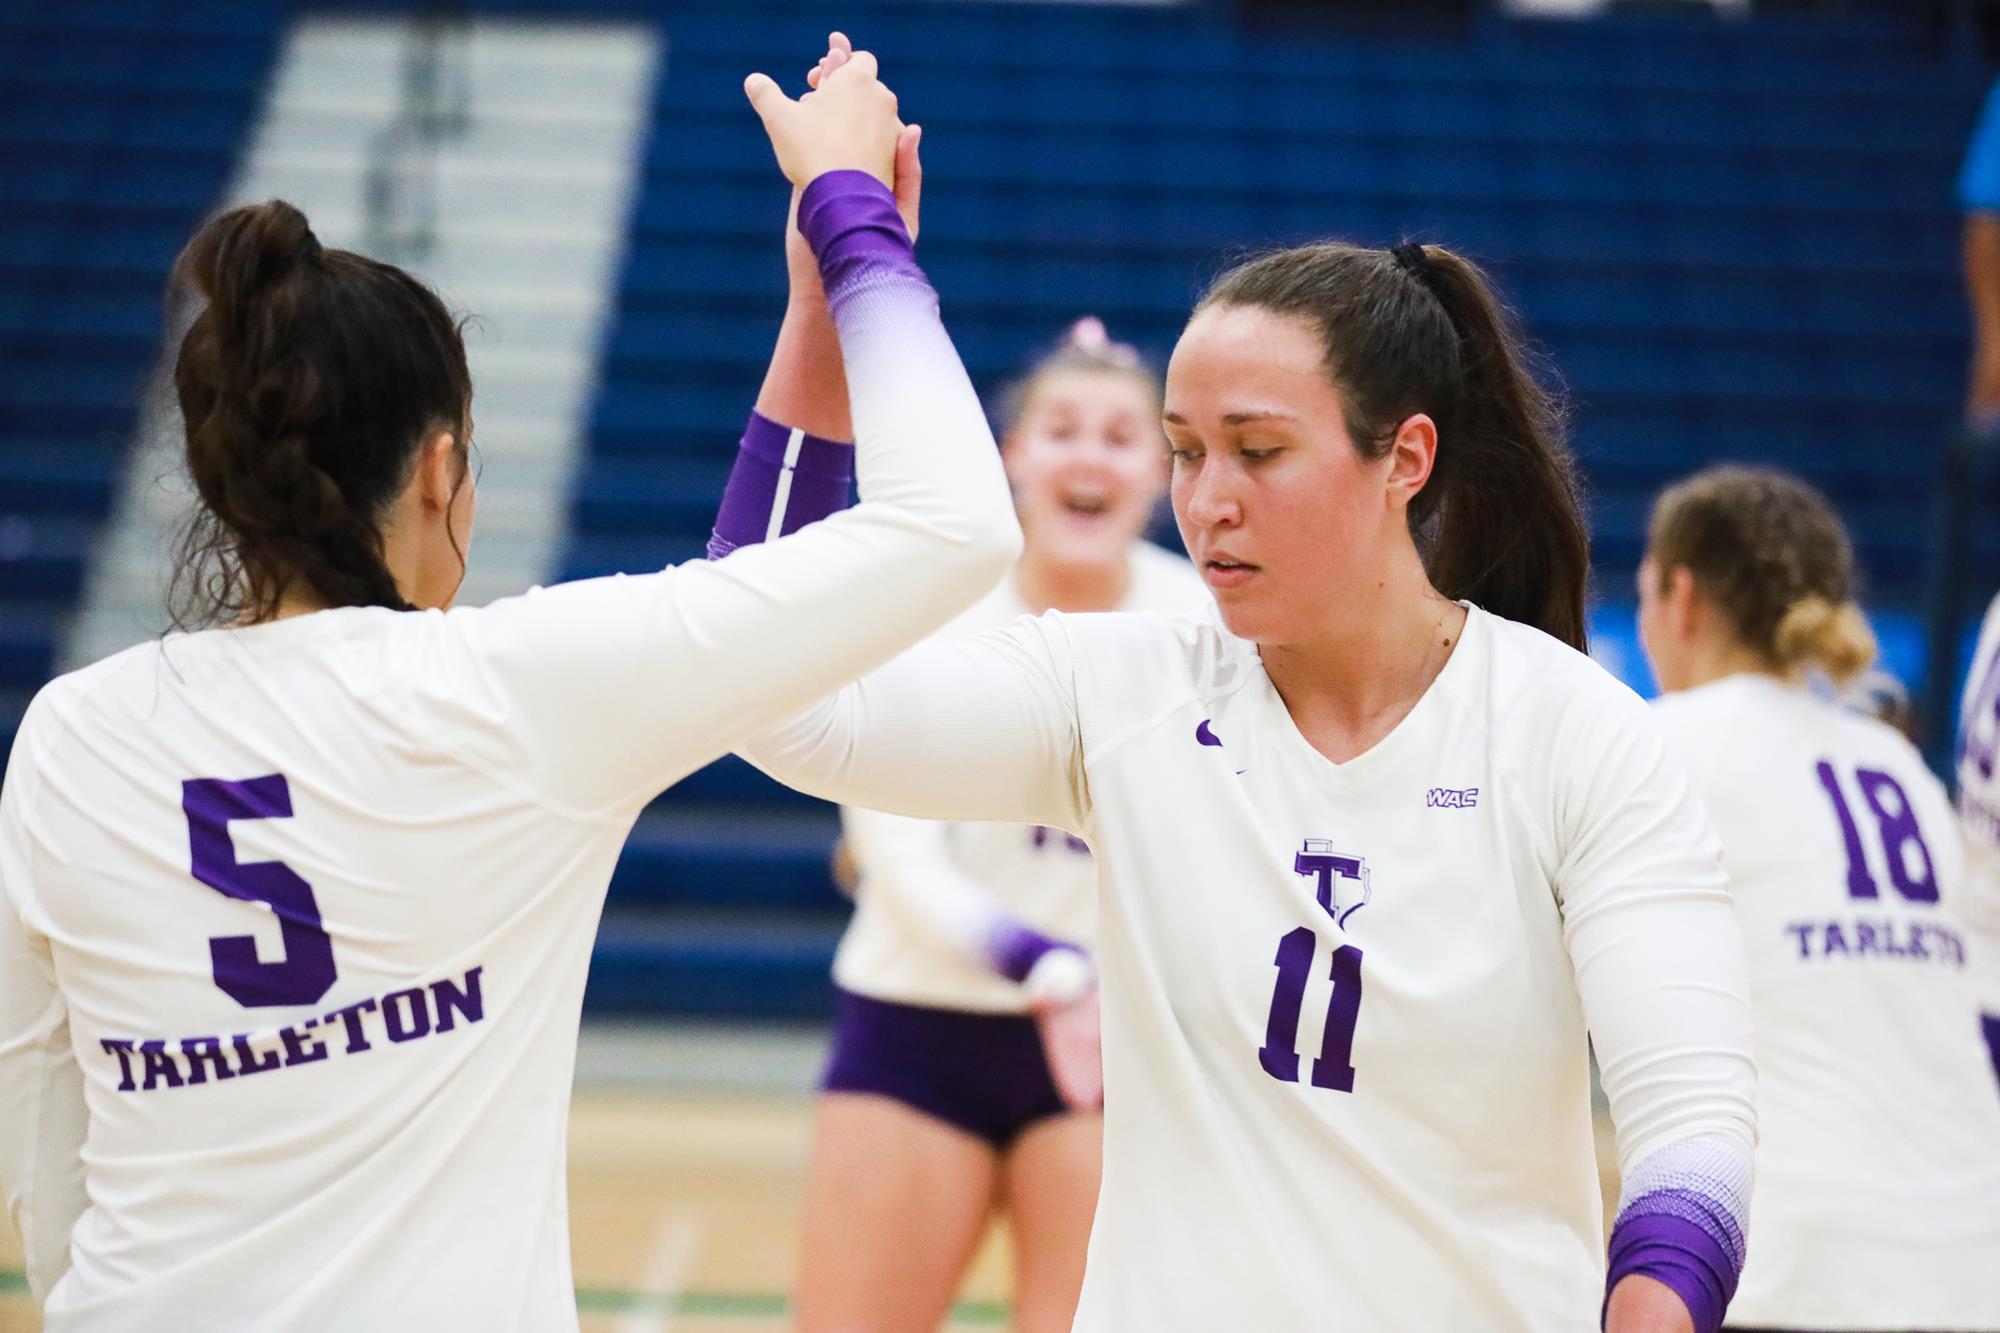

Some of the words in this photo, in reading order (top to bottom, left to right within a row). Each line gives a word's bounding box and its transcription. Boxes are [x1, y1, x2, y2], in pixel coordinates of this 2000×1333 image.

[1427, 787, 1479, 809] WAC
[1816, 761, 1940, 904] 18
[182, 772, 338, 1008] 5
[100, 966, 485, 1092] TARLETON
[1259, 926, 1364, 1093] 11
